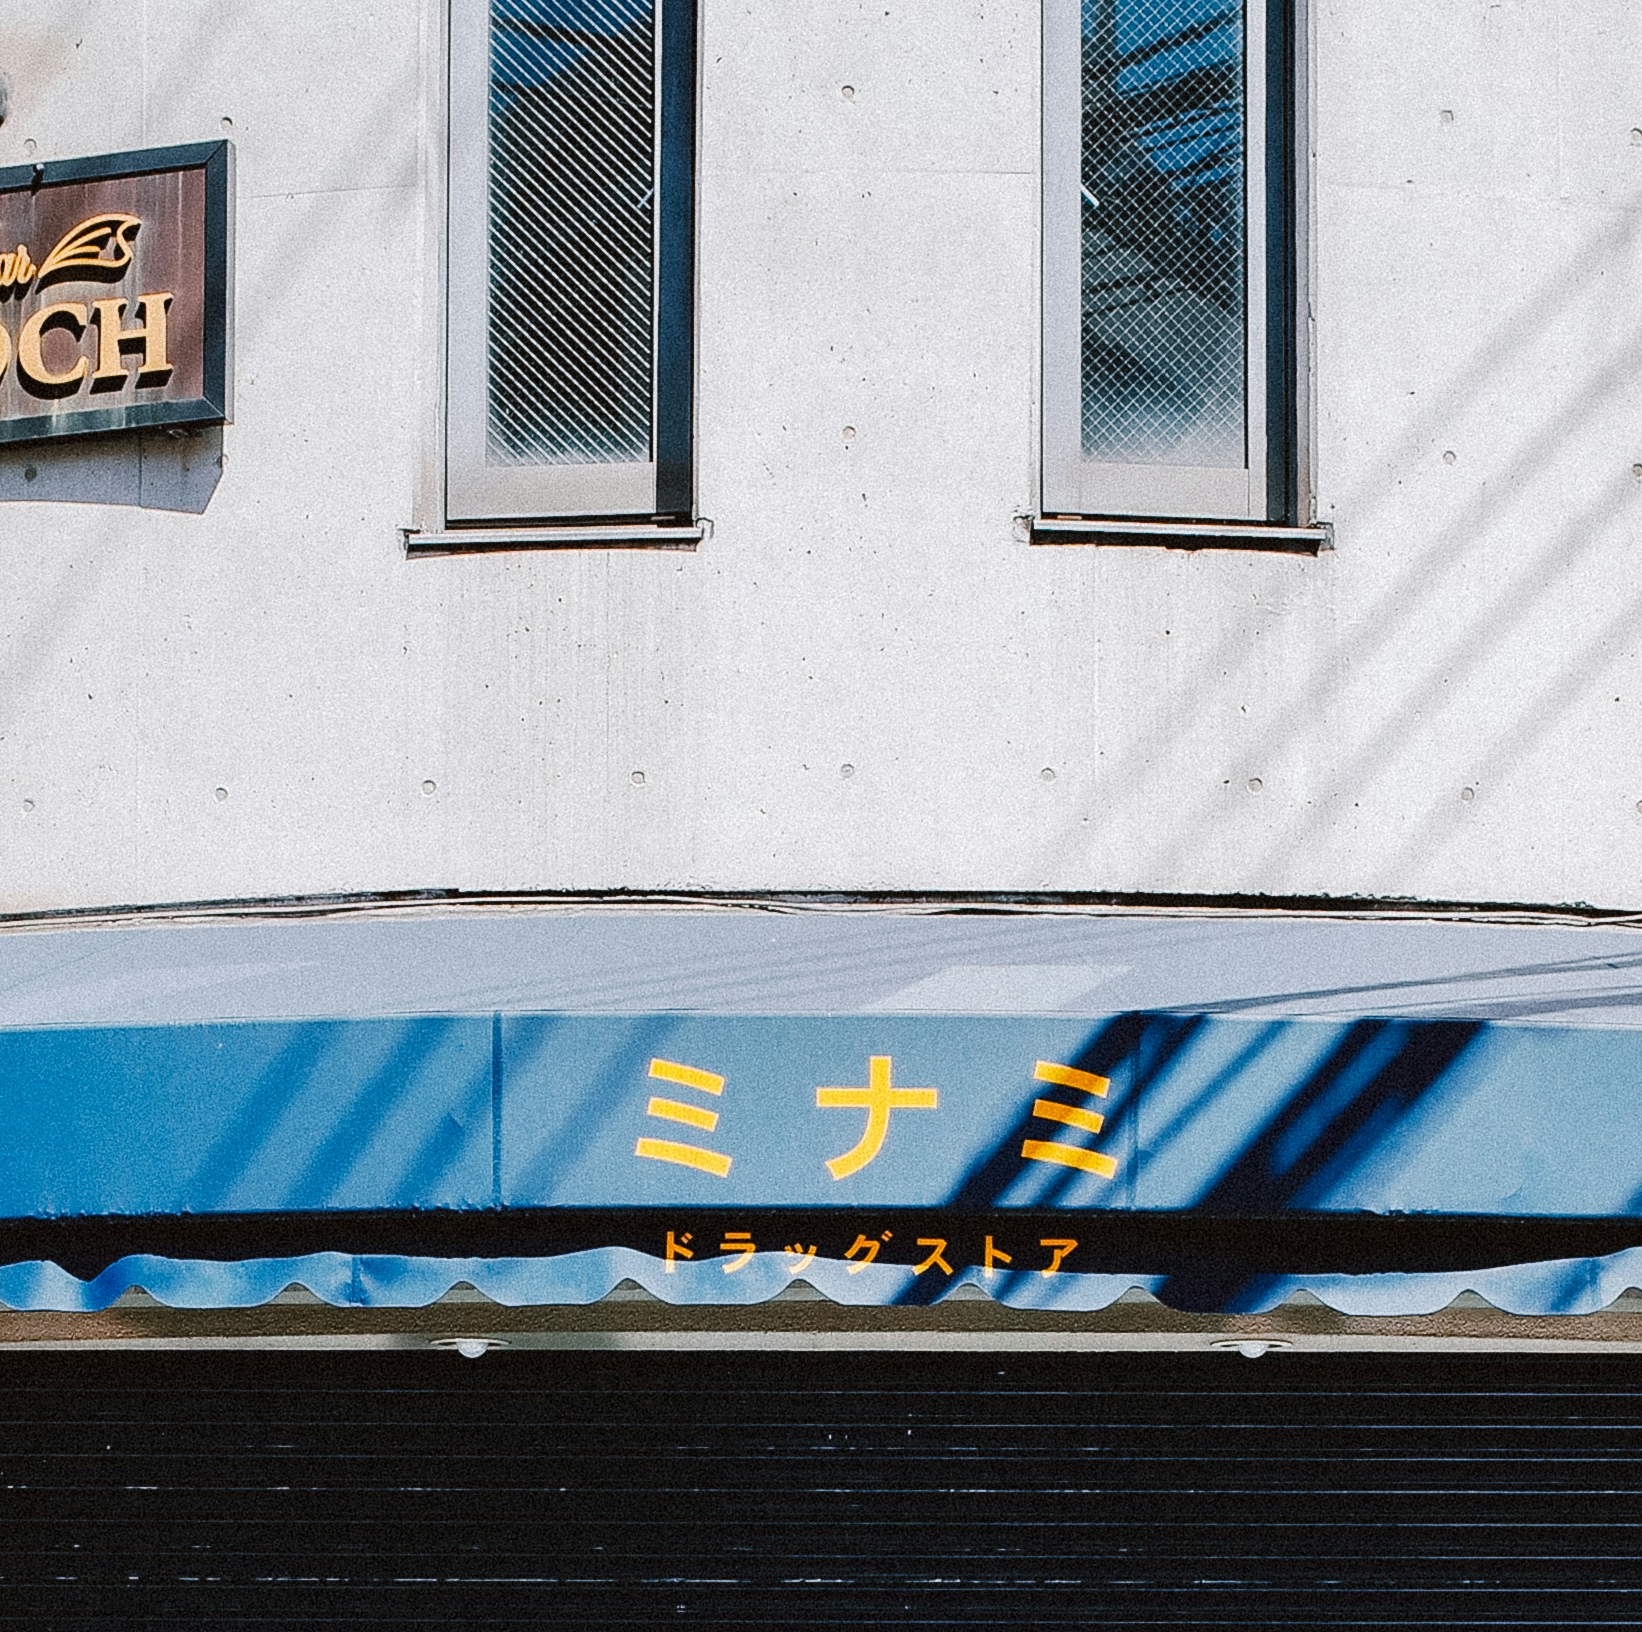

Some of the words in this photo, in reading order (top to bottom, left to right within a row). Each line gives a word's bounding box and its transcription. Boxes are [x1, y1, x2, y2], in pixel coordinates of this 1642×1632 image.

[634, 1054, 1119, 1181] ミナミ
[664, 1229, 1078, 1278] ドラッグストア
